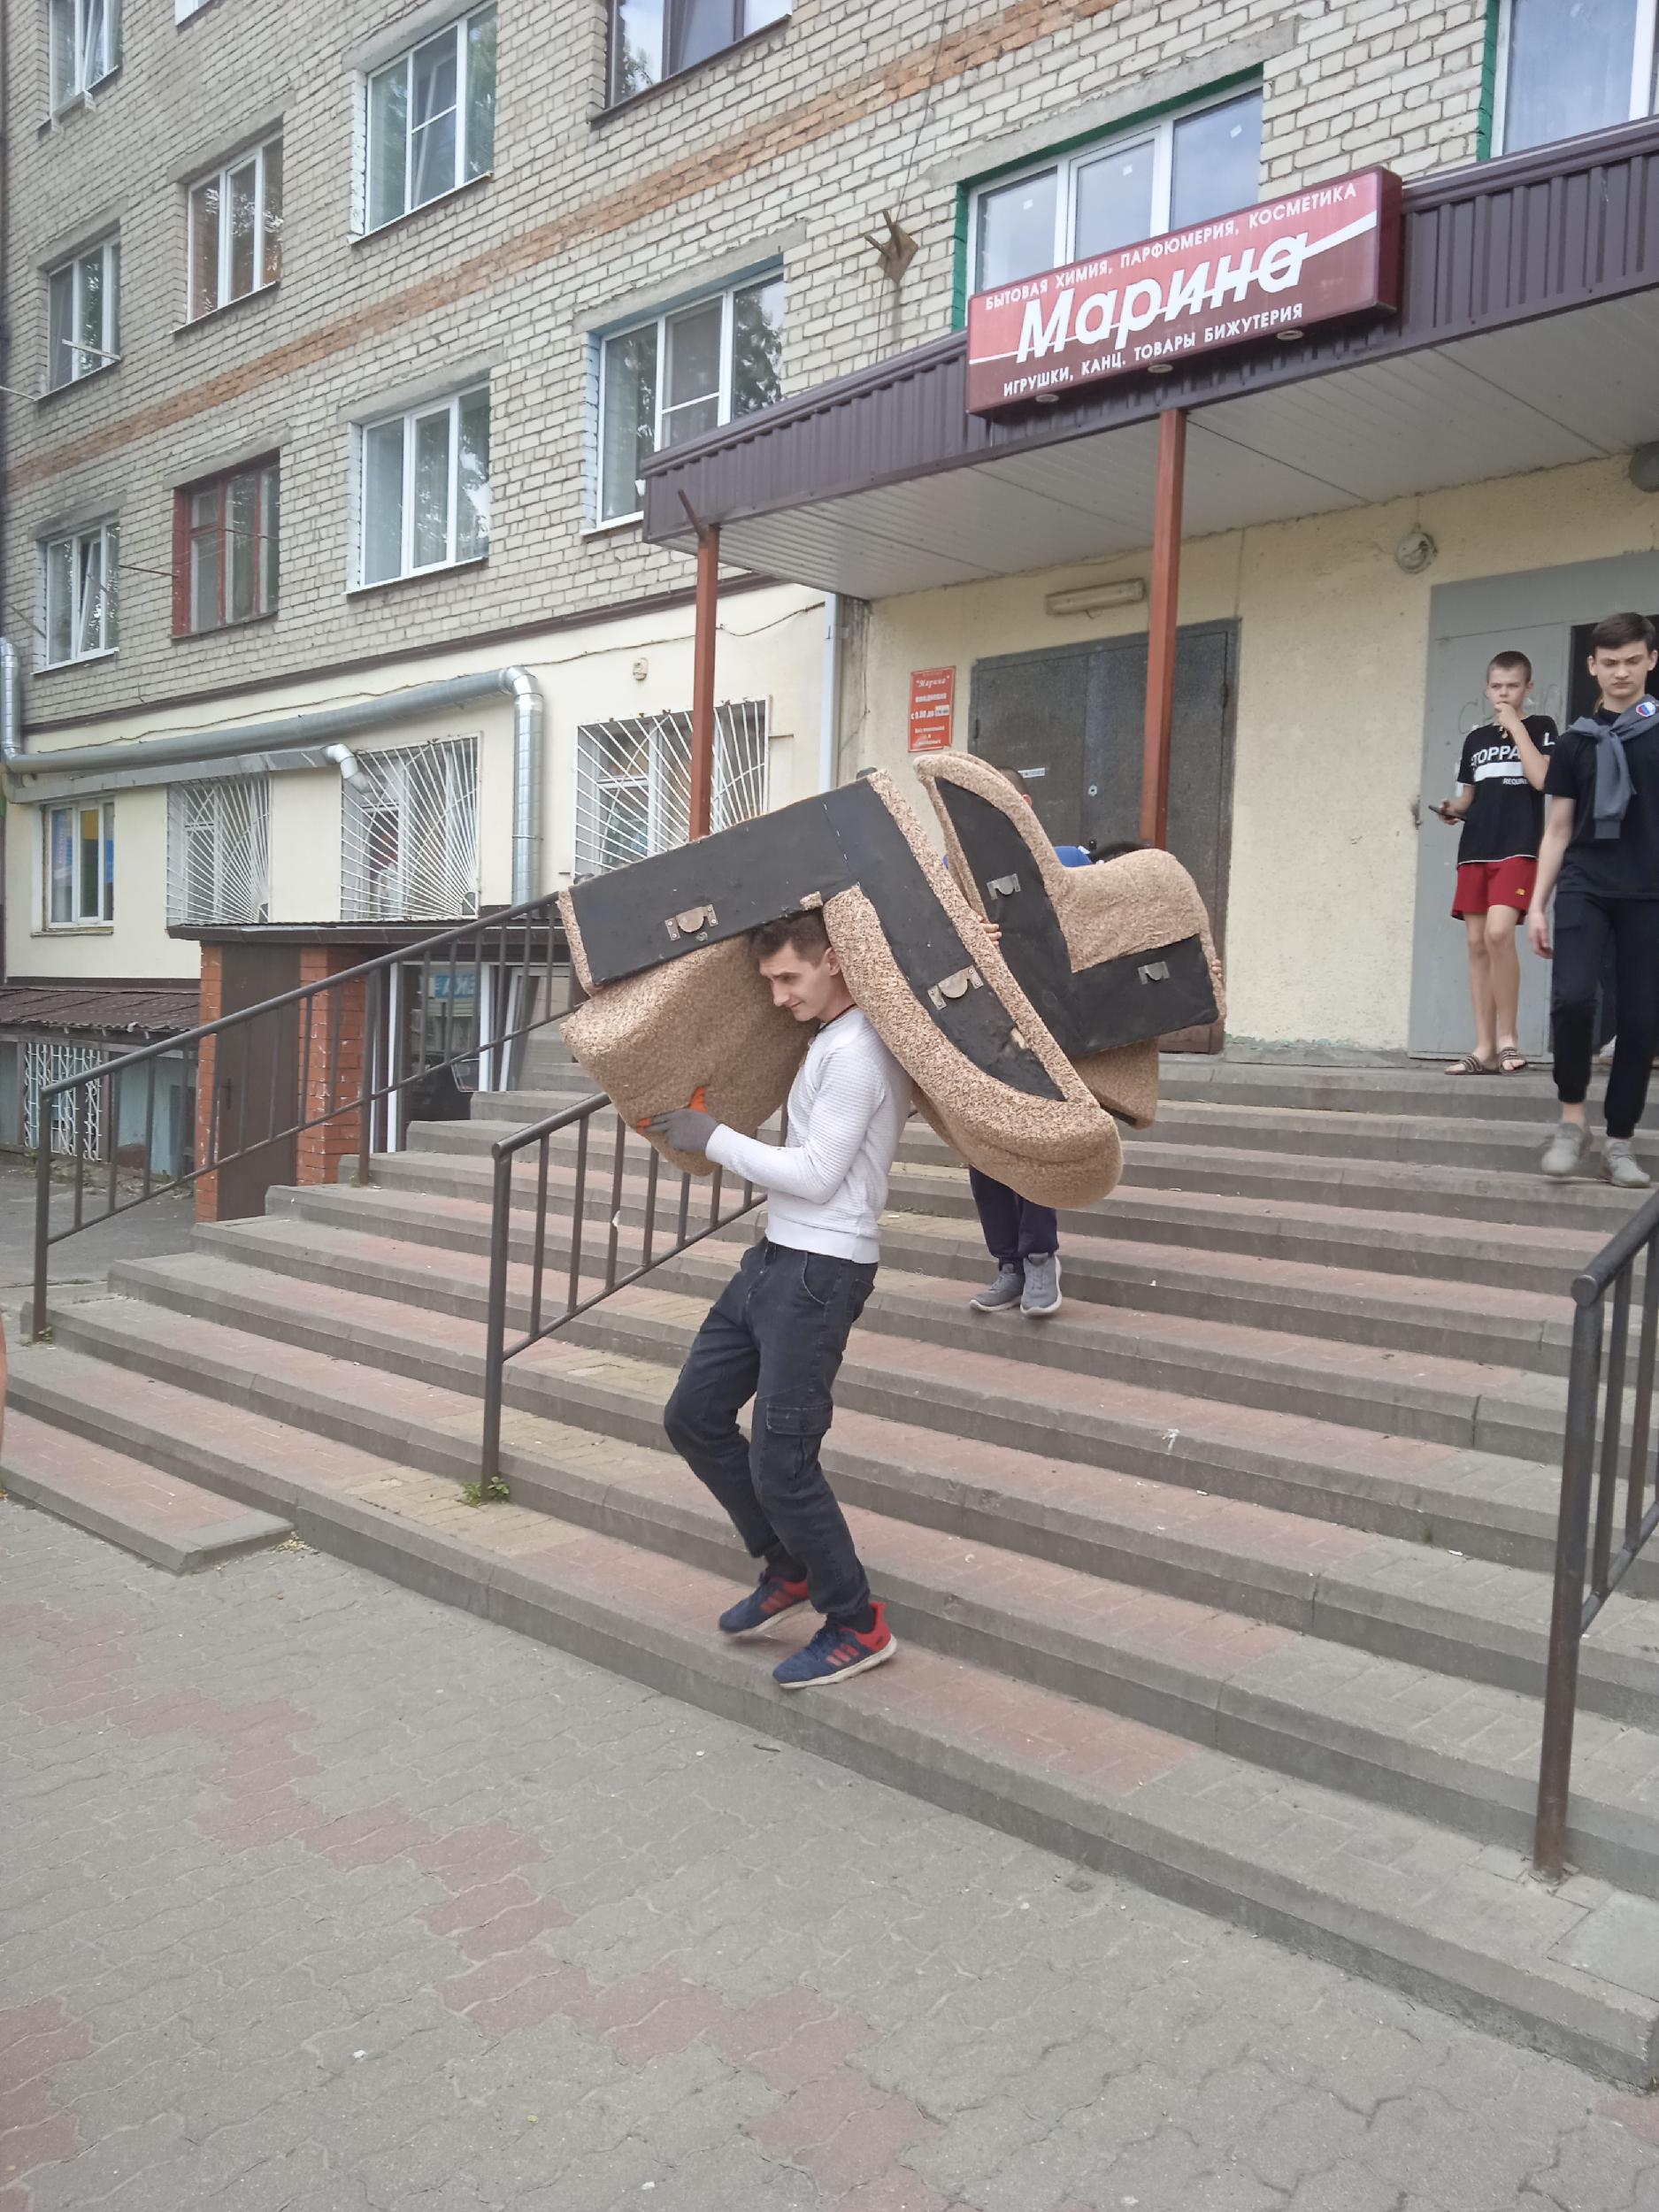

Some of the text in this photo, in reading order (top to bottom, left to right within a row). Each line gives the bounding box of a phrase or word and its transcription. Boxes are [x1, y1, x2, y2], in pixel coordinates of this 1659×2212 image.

[986, 182, 1356, 311] БЫТОВАЯ ХИМИЯ, ПАРФЮМЕРИЯ, КОСМЕТИКА
[1016, 232, 1309, 364] Марина
[1003, 303, 1303, 397] ИГРУШКИ, КАНЦ. ТОВАРЫ БИЖУТЕРИЯ
